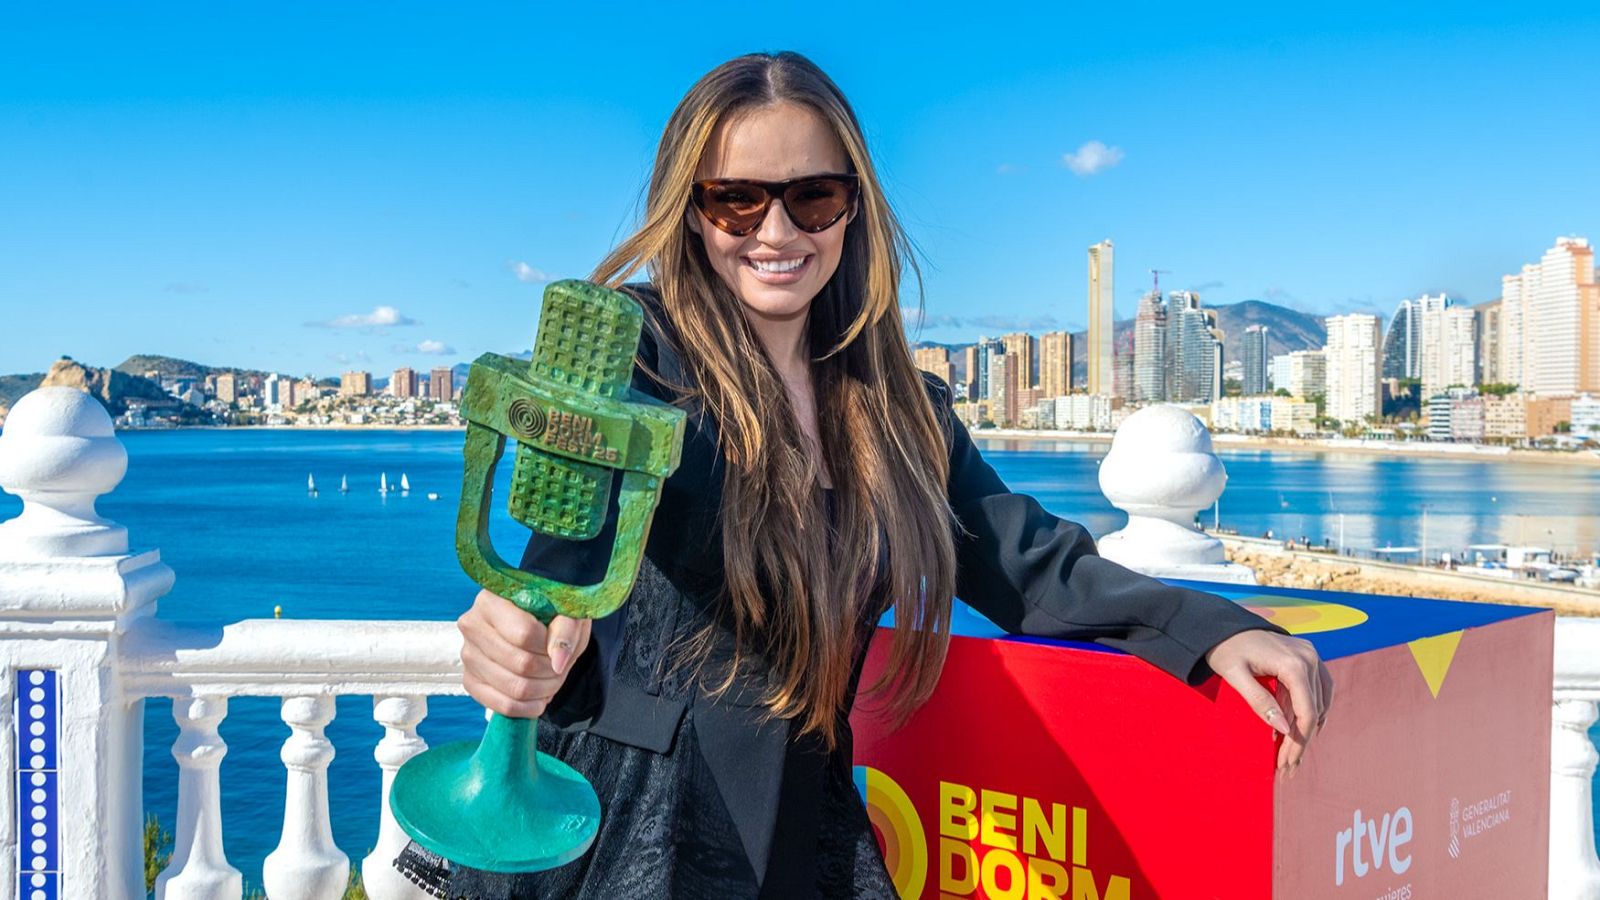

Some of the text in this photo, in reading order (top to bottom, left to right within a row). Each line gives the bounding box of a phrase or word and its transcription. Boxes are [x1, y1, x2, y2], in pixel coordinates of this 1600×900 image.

[548, 407, 592, 432] BENI
[592, 446, 617, 461] 25
[1463, 790, 1512, 821] GENERALITAT
[940, 780, 1087, 867] BENI
[1463, 809, 1510, 838] VALENCIANA
[1336, 807, 1413, 886] rtve
[940, 836, 1130, 900] DORM
